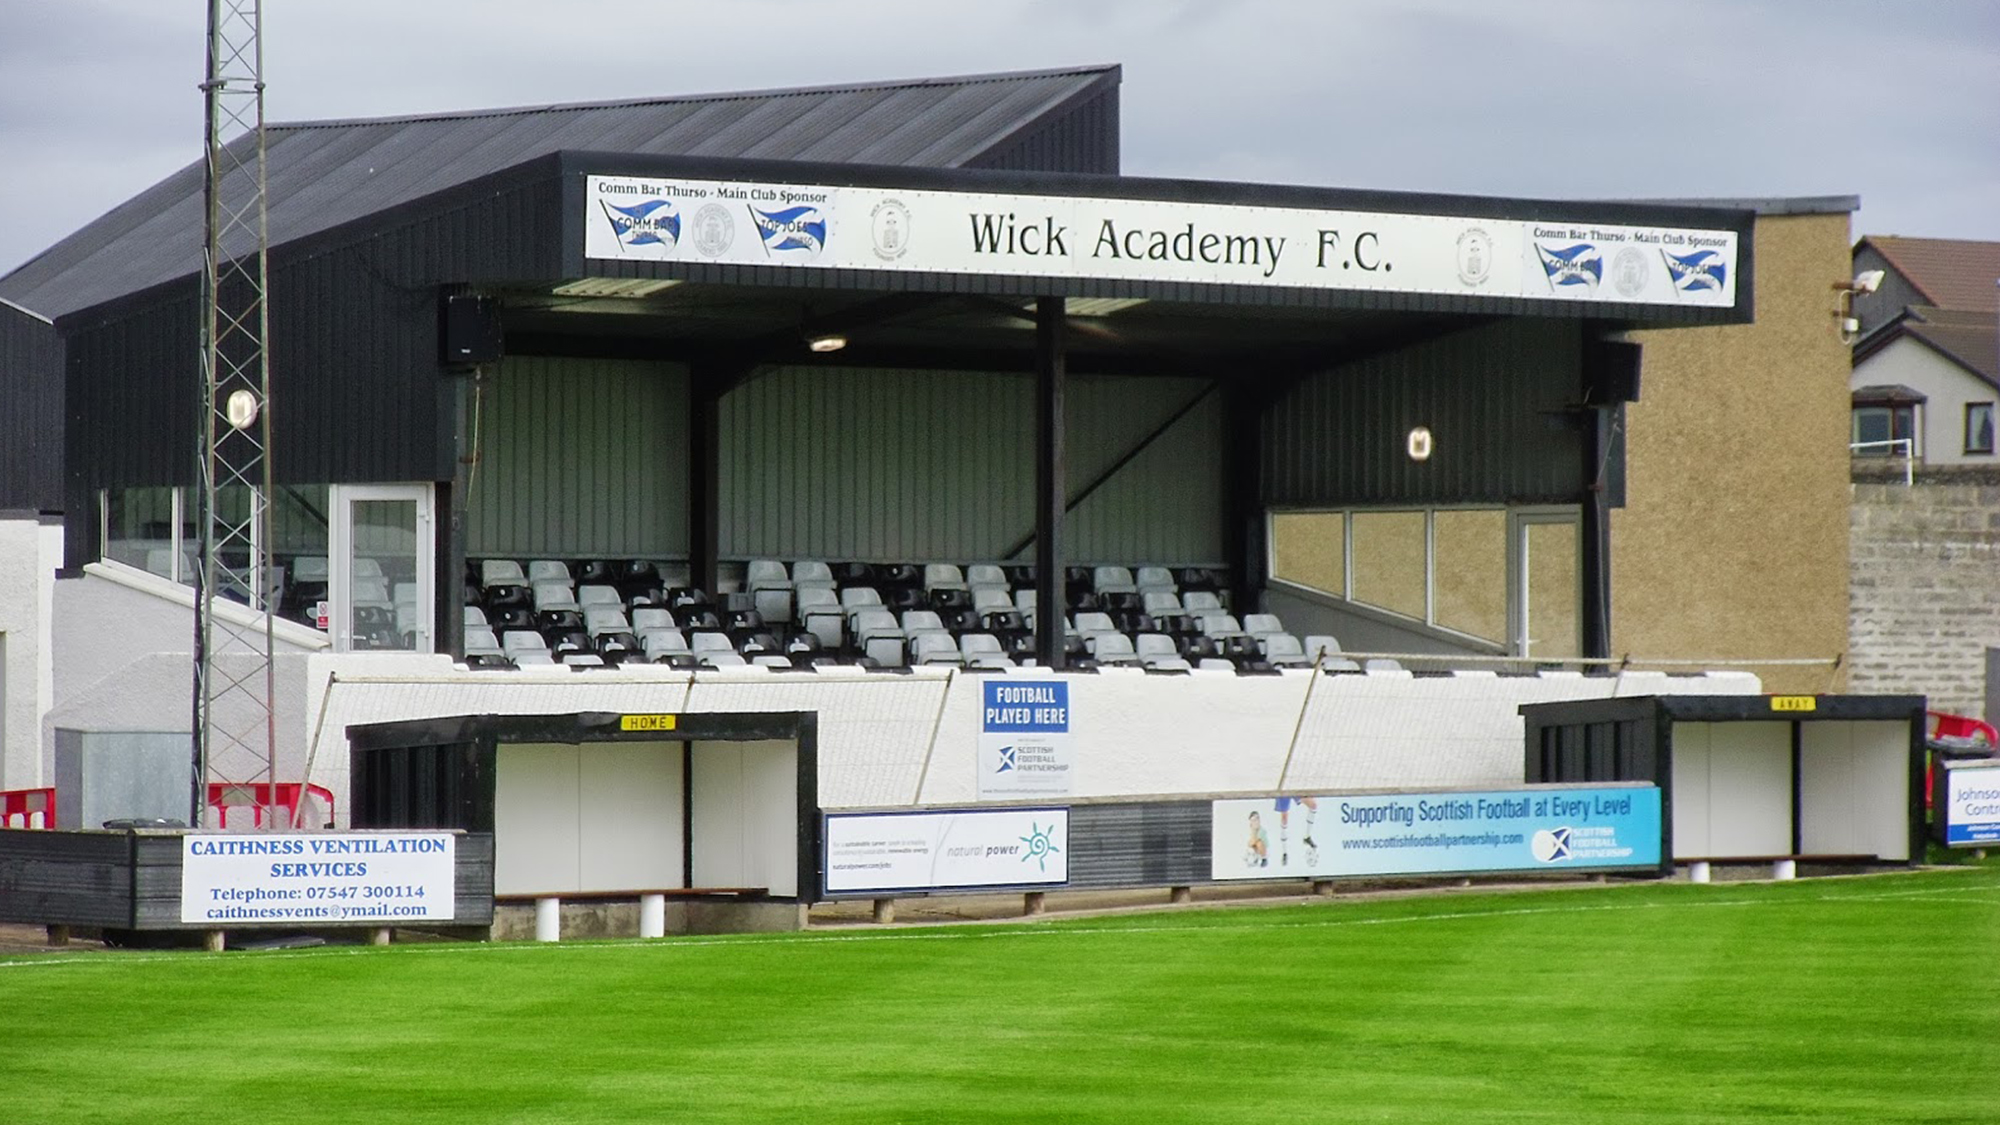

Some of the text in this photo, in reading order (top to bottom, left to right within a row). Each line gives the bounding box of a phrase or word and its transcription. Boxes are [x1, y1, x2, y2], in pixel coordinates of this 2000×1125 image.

[599, 182, 638, 194] Comm
[641, 184, 662, 195] Bar
[665, 185, 707, 198] Thurso
[717, 187, 747, 199] Main
[751, 188, 777, 200] Club
[780, 190, 827, 204] Sponsor
[617, 217, 651, 230] COMM
[969, 213, 1393, 278] Wick Academy F.C.
[1533, 227, 1566, 239] Comm
[1569, 229, 1587, 240] Bar
[1590, 230, 1626, 242] Thurso
[1634, 231, 1660, 243] Main
[1663, 233, 1685, 244] Club
[1688, 235, 1728, 248] Sponsor
[996, 687, 1056, 703] FOOTBALL
[630, 717, 666, 729] HOME
[986, 708, 1066, 724] PLAYED HERE
[1017, 746, 1054, 754] SCOTTISH
[1017, 755, 1056, 763] FOOTBALL
[1340, 795, 1631, 827] Supporting Scottish Football at Every Level
[191, 839, 446, 856] CAITHNESS VENTILATION
[1342, 831, 1524, 849] www.scottishfootballpartnership.com
[947, 844, 1019, 858] natural power
[270, 862, 367, 878] SERVICES
[210, 885, 425, 903] Telephone: 07547 300114
[206, 902, 427, 919] caithnessvents@ymail.com
